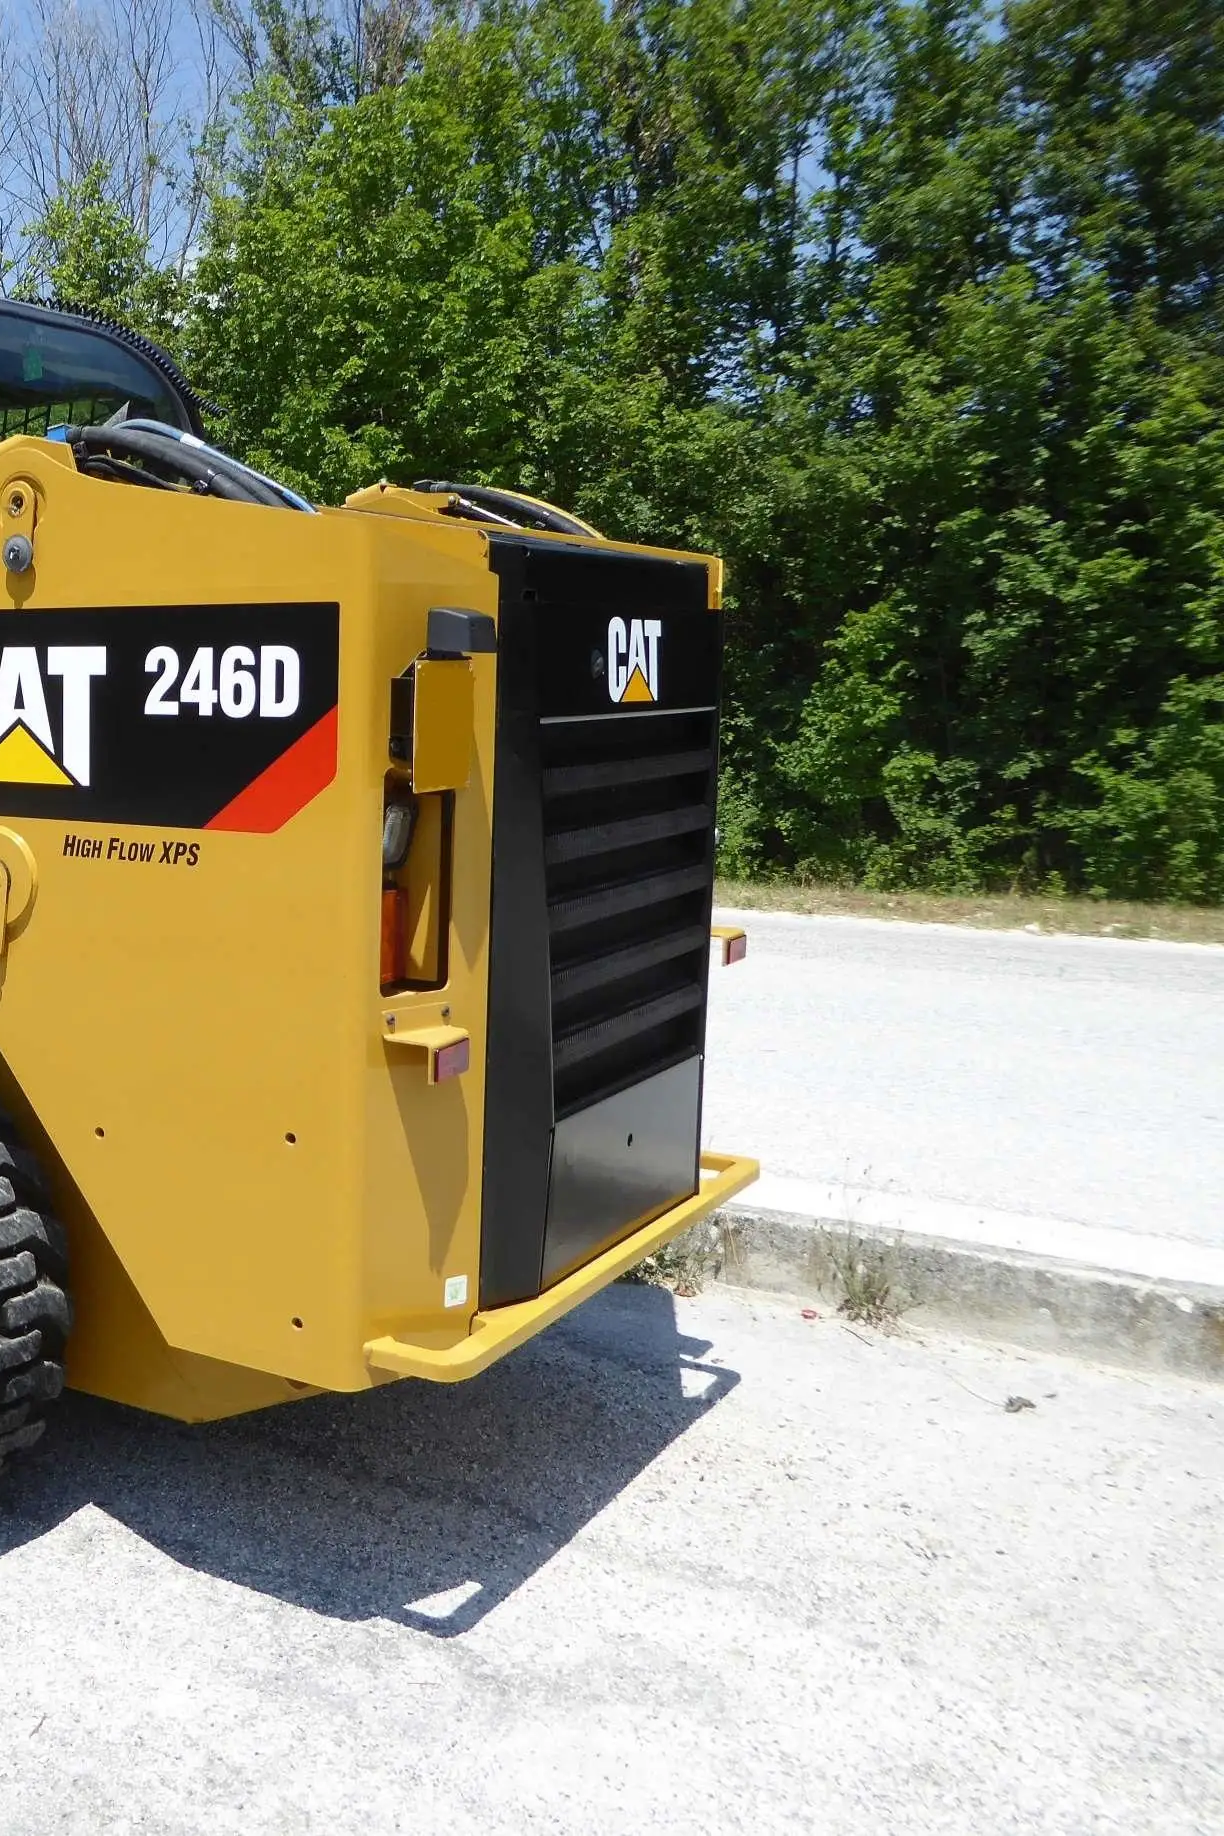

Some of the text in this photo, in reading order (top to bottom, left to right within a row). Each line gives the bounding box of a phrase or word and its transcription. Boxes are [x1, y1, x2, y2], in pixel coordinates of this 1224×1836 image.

[143, 645, 300, 719] 246D
[607, 616, 662, 703] CAT
[158, 840, 201, 866] XPS
